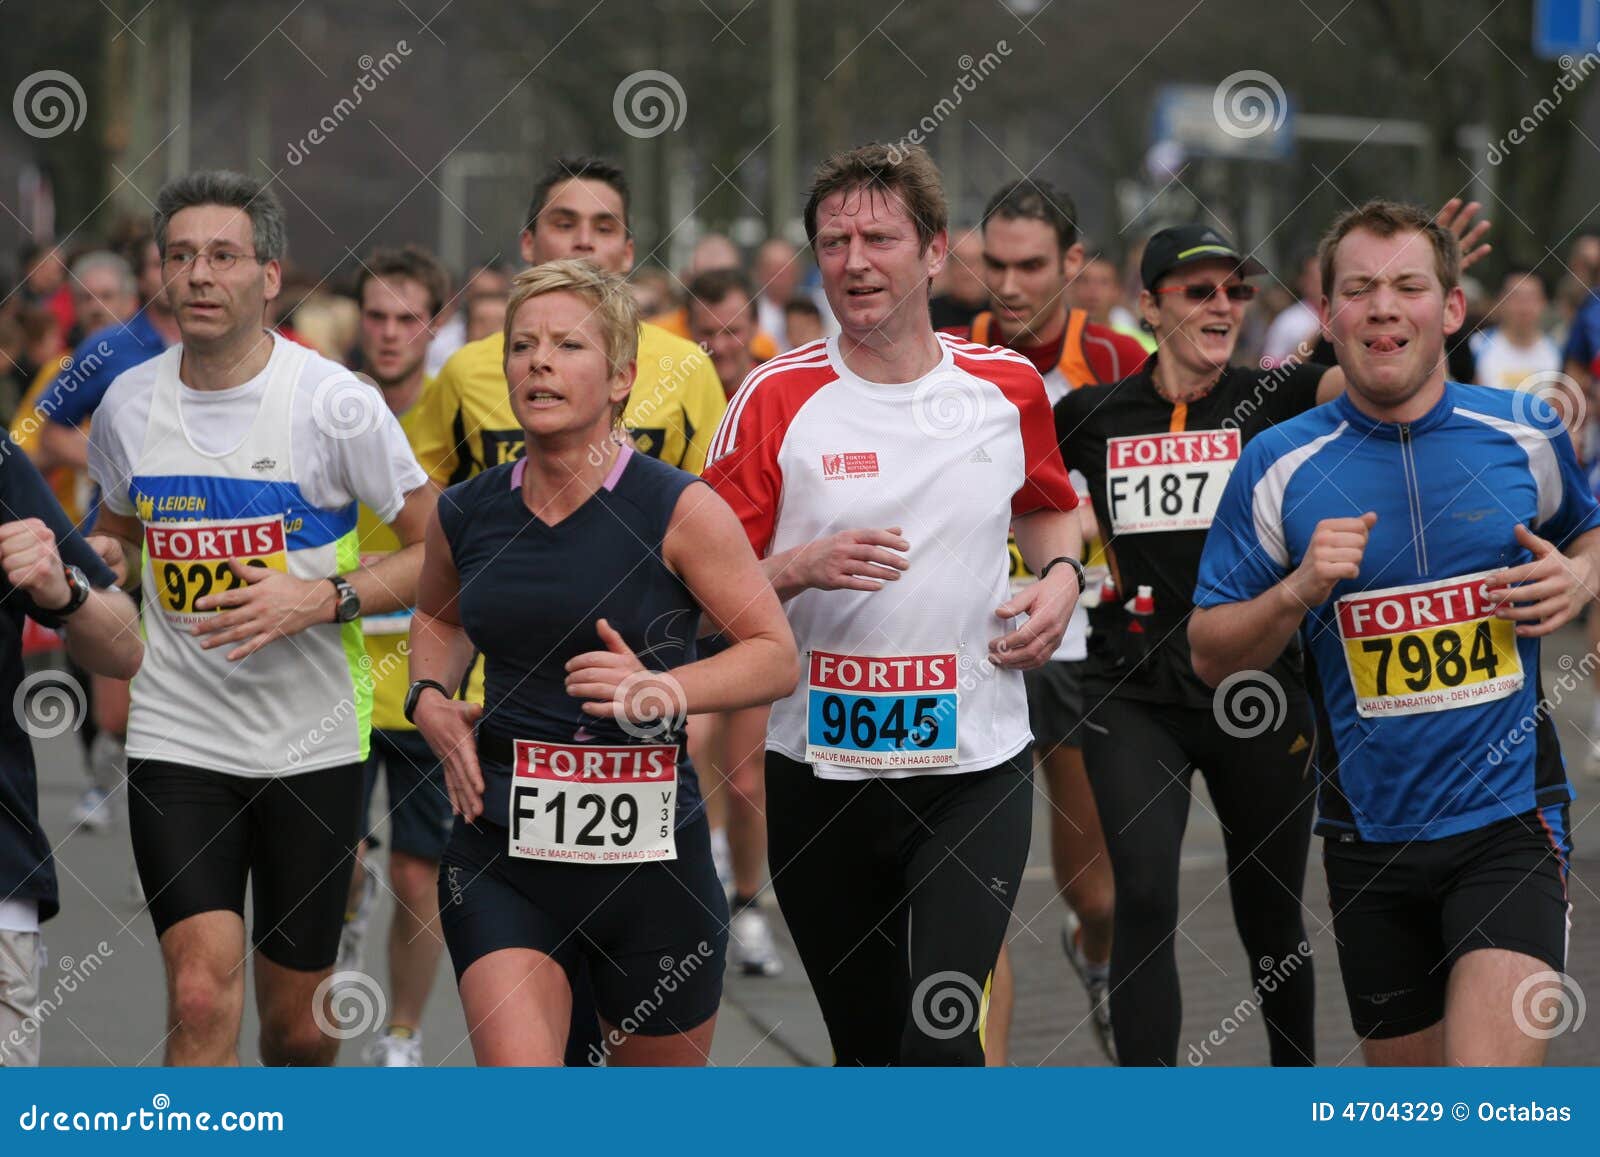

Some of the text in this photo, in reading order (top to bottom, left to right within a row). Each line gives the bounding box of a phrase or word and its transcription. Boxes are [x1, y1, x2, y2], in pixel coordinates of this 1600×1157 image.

[1117, 434, 1229, 467] FORTIS
[158, 496, 207, 511] LEIDEN
[1110, 472, 1209, 520] F187
[152, 525, 273, 558] FORTIS
[285, 517, 303, 534] UB
[163, 558, 269, 614] 922
[1350, 583, 1497, 633] FORTIS
[819, 656, 946, 688] FORTIS
[1361, 620, 1499, 697] 7984
[1366, 700, 1393, 712] HALVE
[1394, 695, 1444, 709] MARATHON
[1451, 691, 1470, 702] DEN
[1471, 685, 1496, 697] HAAG
[822, 695, 939, 749] 9645
[527, 747, 664, 779] FORTIS
[815, 751, 839, 762] HALVE
[839, 754, 883, 766] MARATHON
[889, 757, 906, 765] DEN
[907, 755, 930, 764] HAAG
[932, 755, 949, 764] 2008
[513, 786, 639, 847] F129
[519, 847, 546, 858] HALVE
[548, 849, 596, 861] MARATHON
[602, 851, 619, 861] DEN
[620, 850, 645, 860] HAAG
